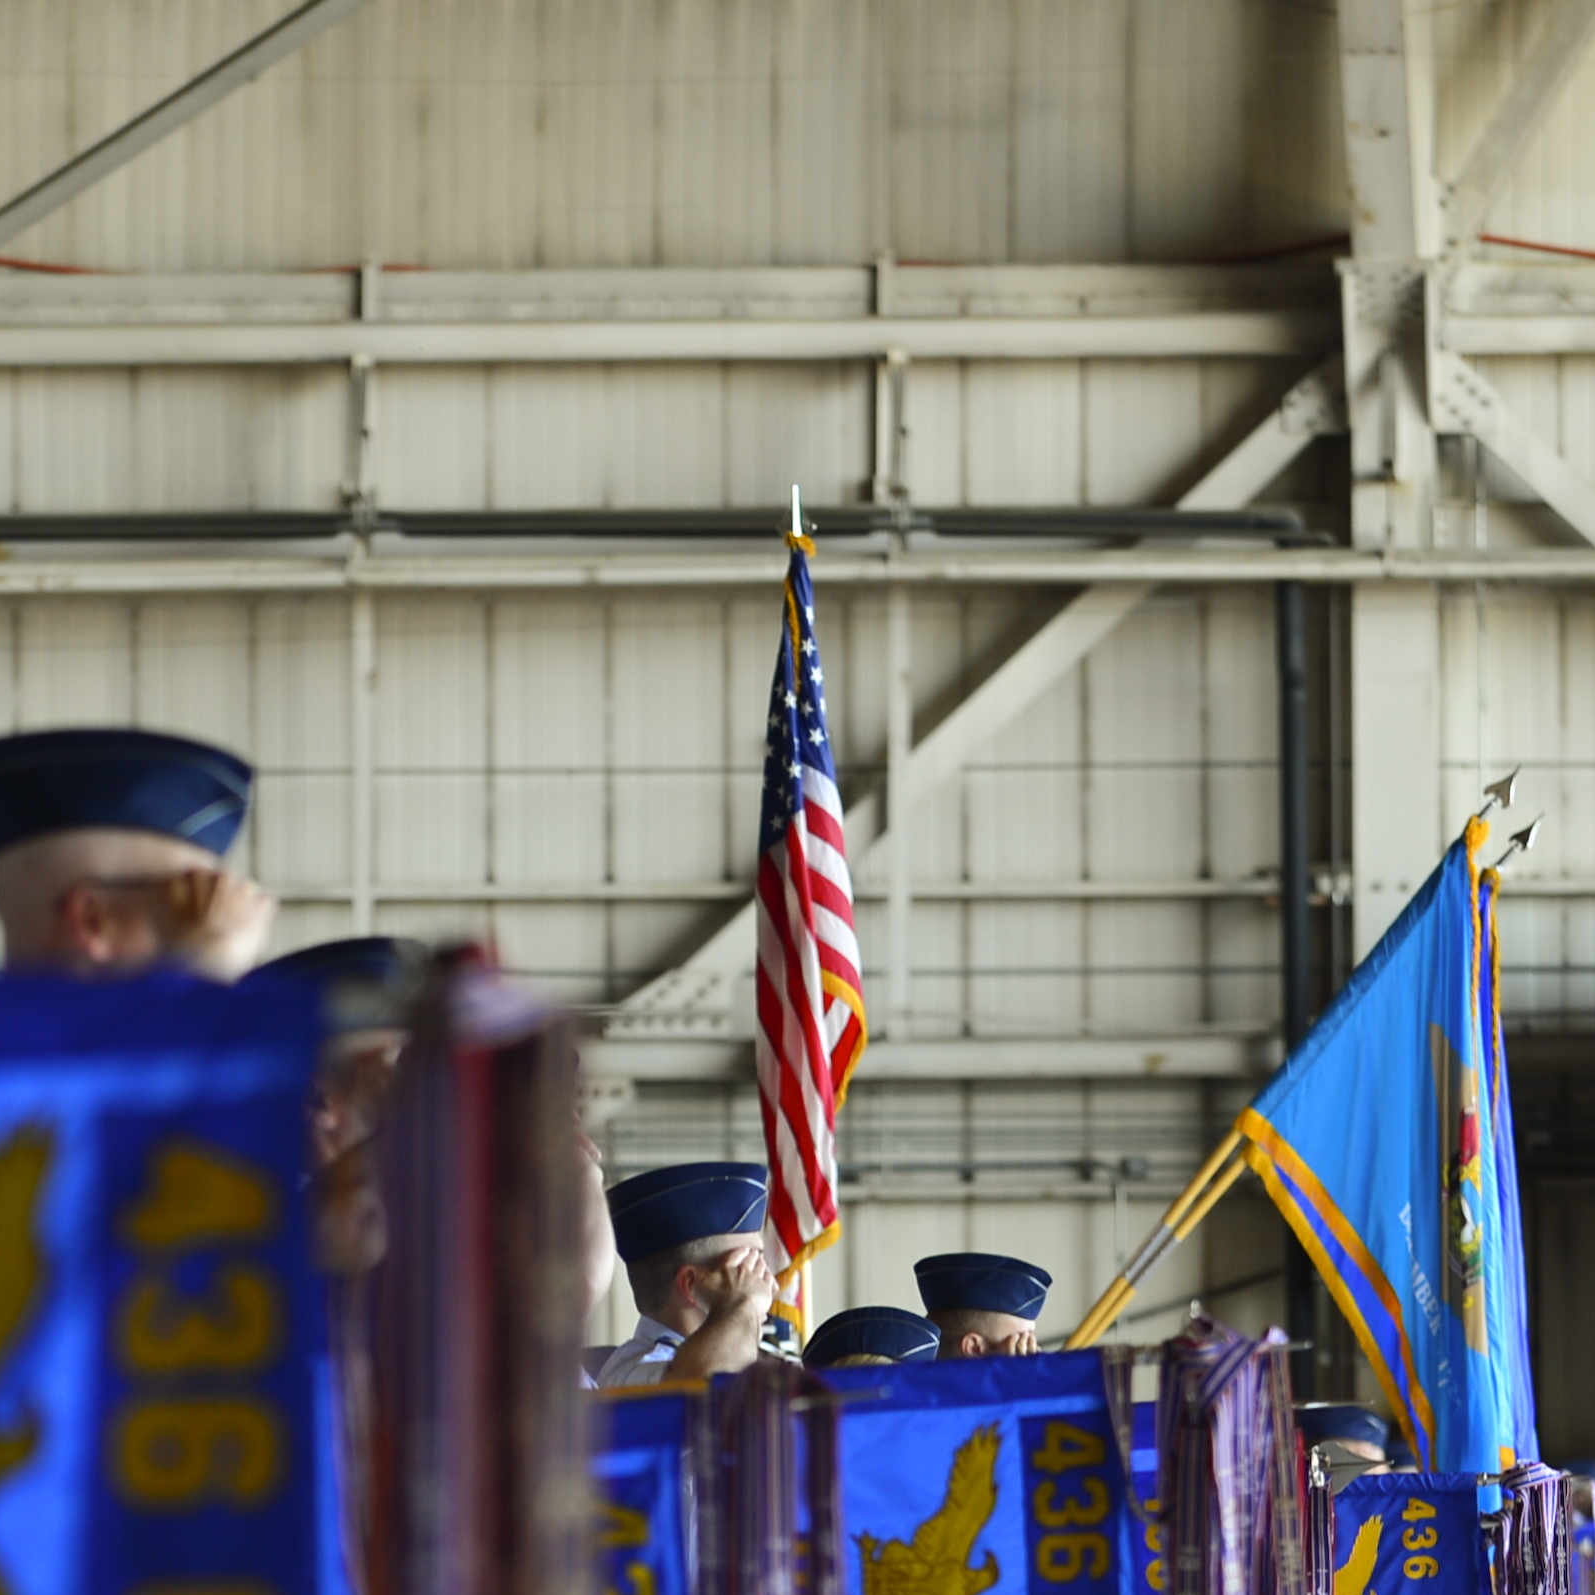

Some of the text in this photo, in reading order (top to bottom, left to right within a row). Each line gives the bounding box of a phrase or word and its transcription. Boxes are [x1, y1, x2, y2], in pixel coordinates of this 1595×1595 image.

[117, 1138, 279, 1510] 436
[1032, 1421, 1111, 1583] 436
[1403, 1498, 1439, 1581] 436
